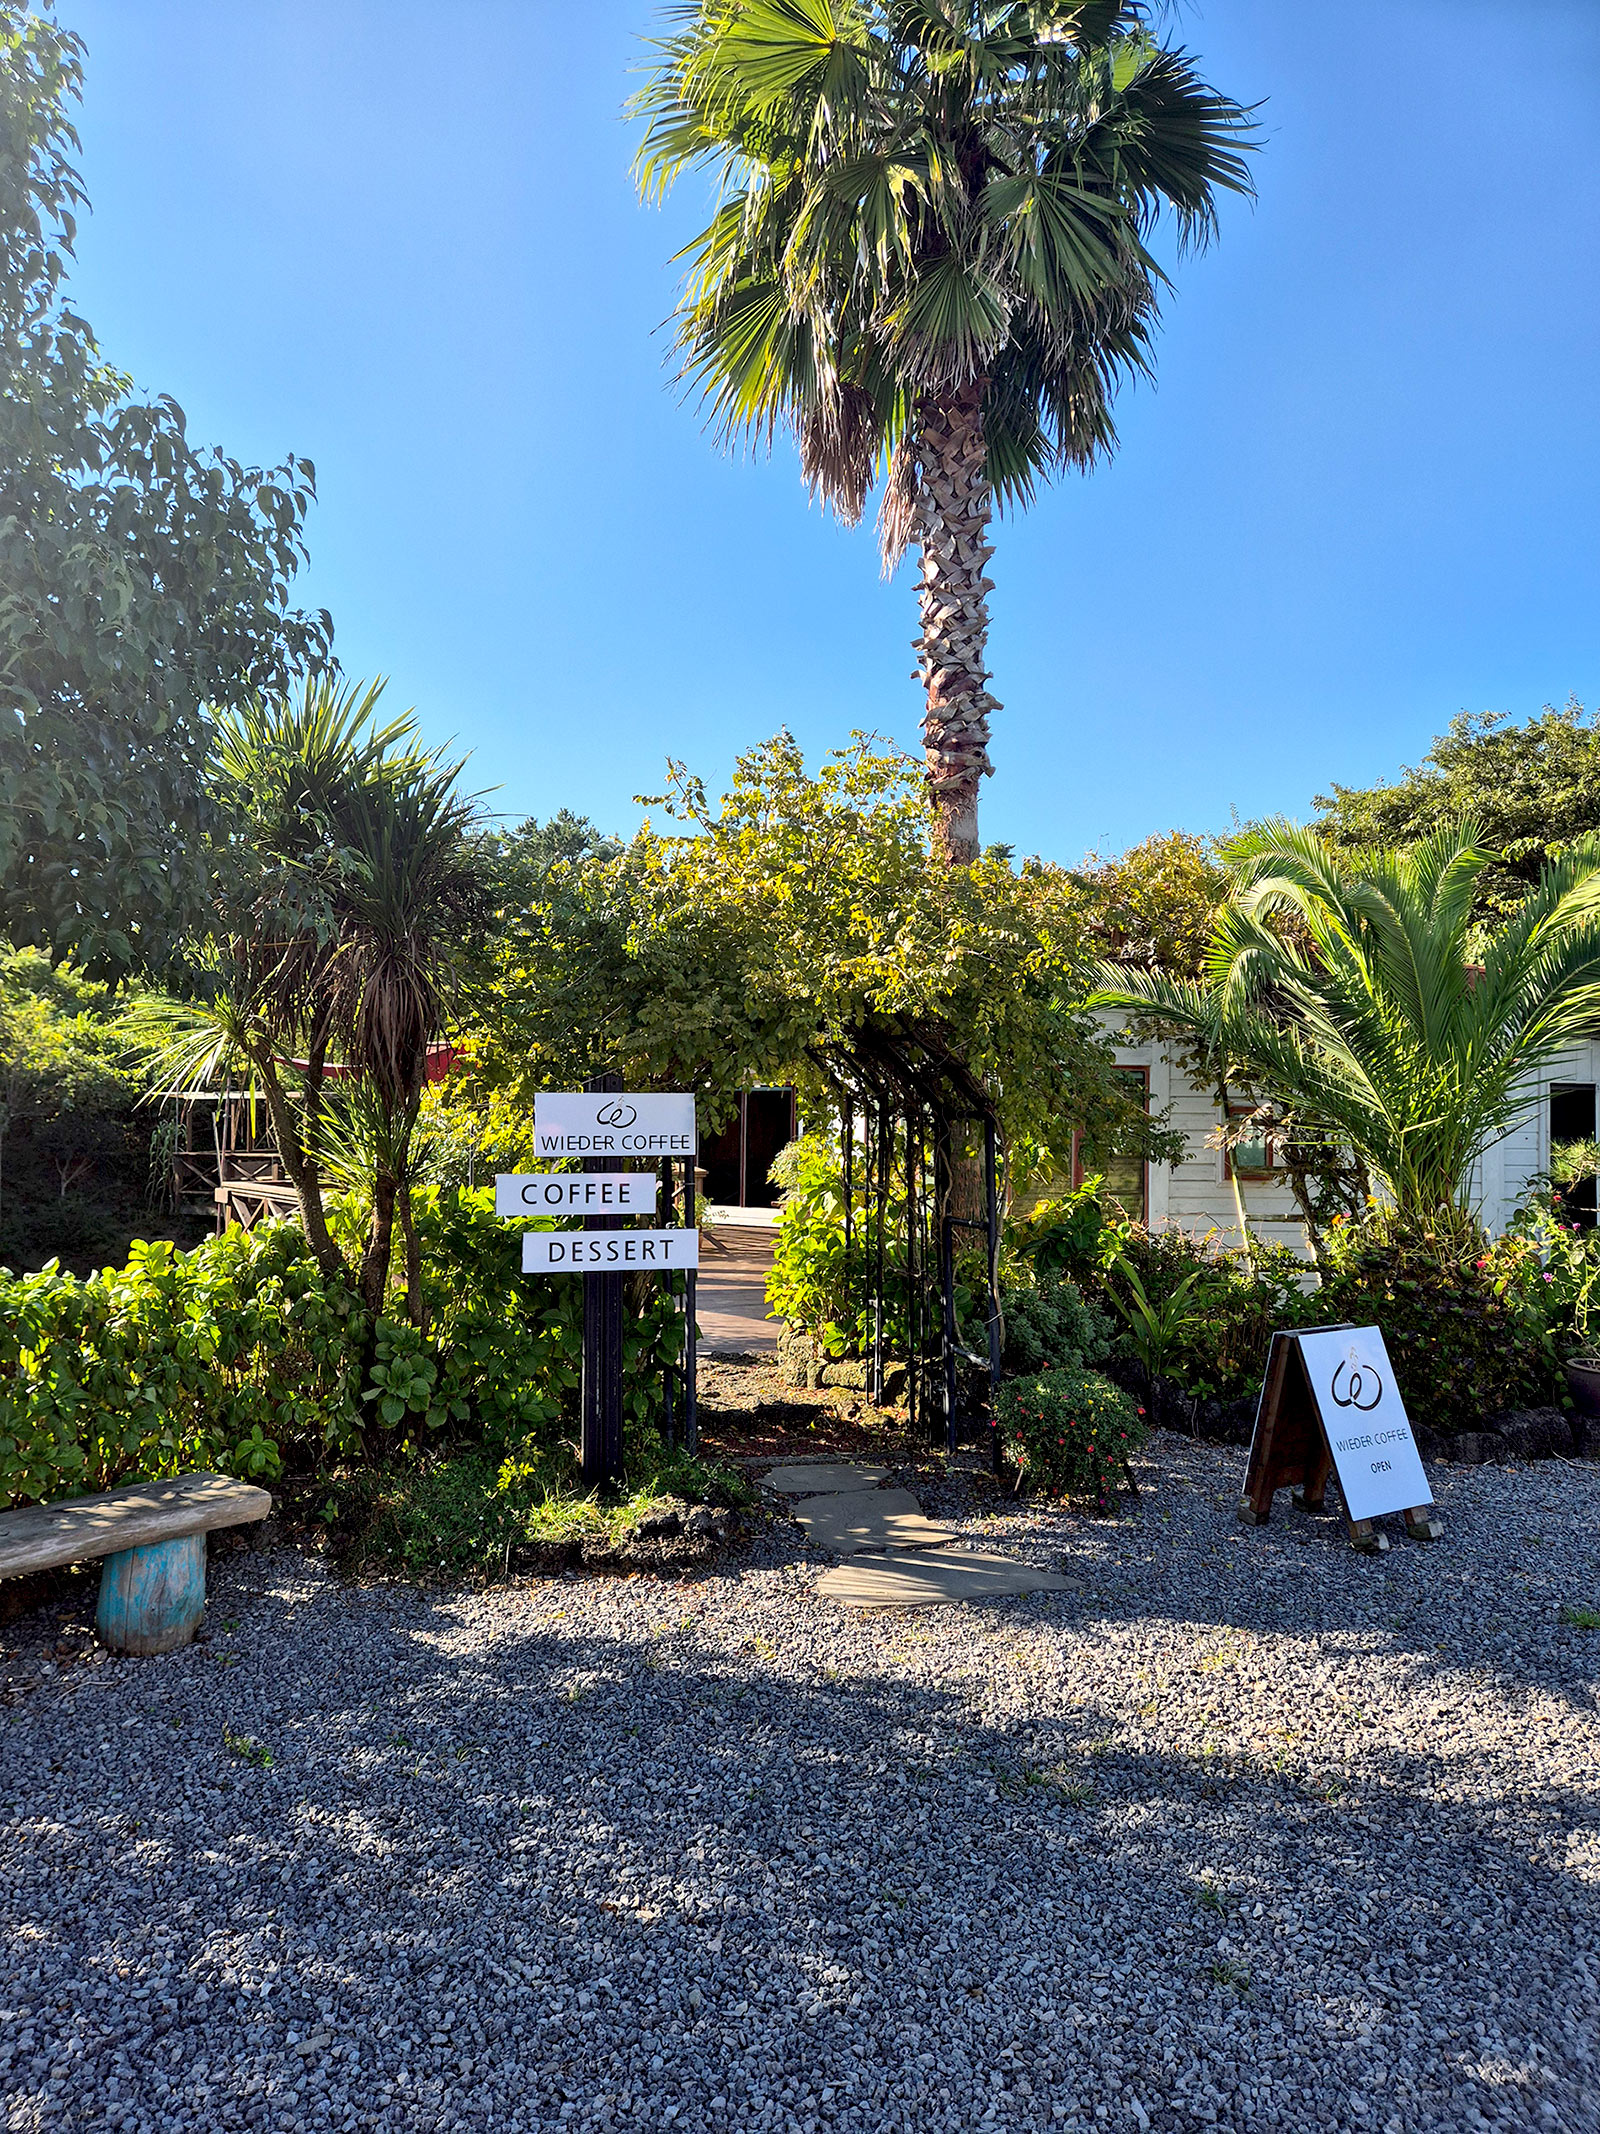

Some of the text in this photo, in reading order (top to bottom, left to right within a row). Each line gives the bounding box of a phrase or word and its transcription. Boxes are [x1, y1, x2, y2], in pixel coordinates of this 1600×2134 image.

[541, 1134, 690, 1151] WIEDER COFFEE
[521, 1183, 631, 1205] COFFEE
[548, 1240, 674, 1262] DESSERT
[1336, 1428, 1409, 1452] WIEDER COFFEE
[1370, 1460, 1392, 1474] OPEN
